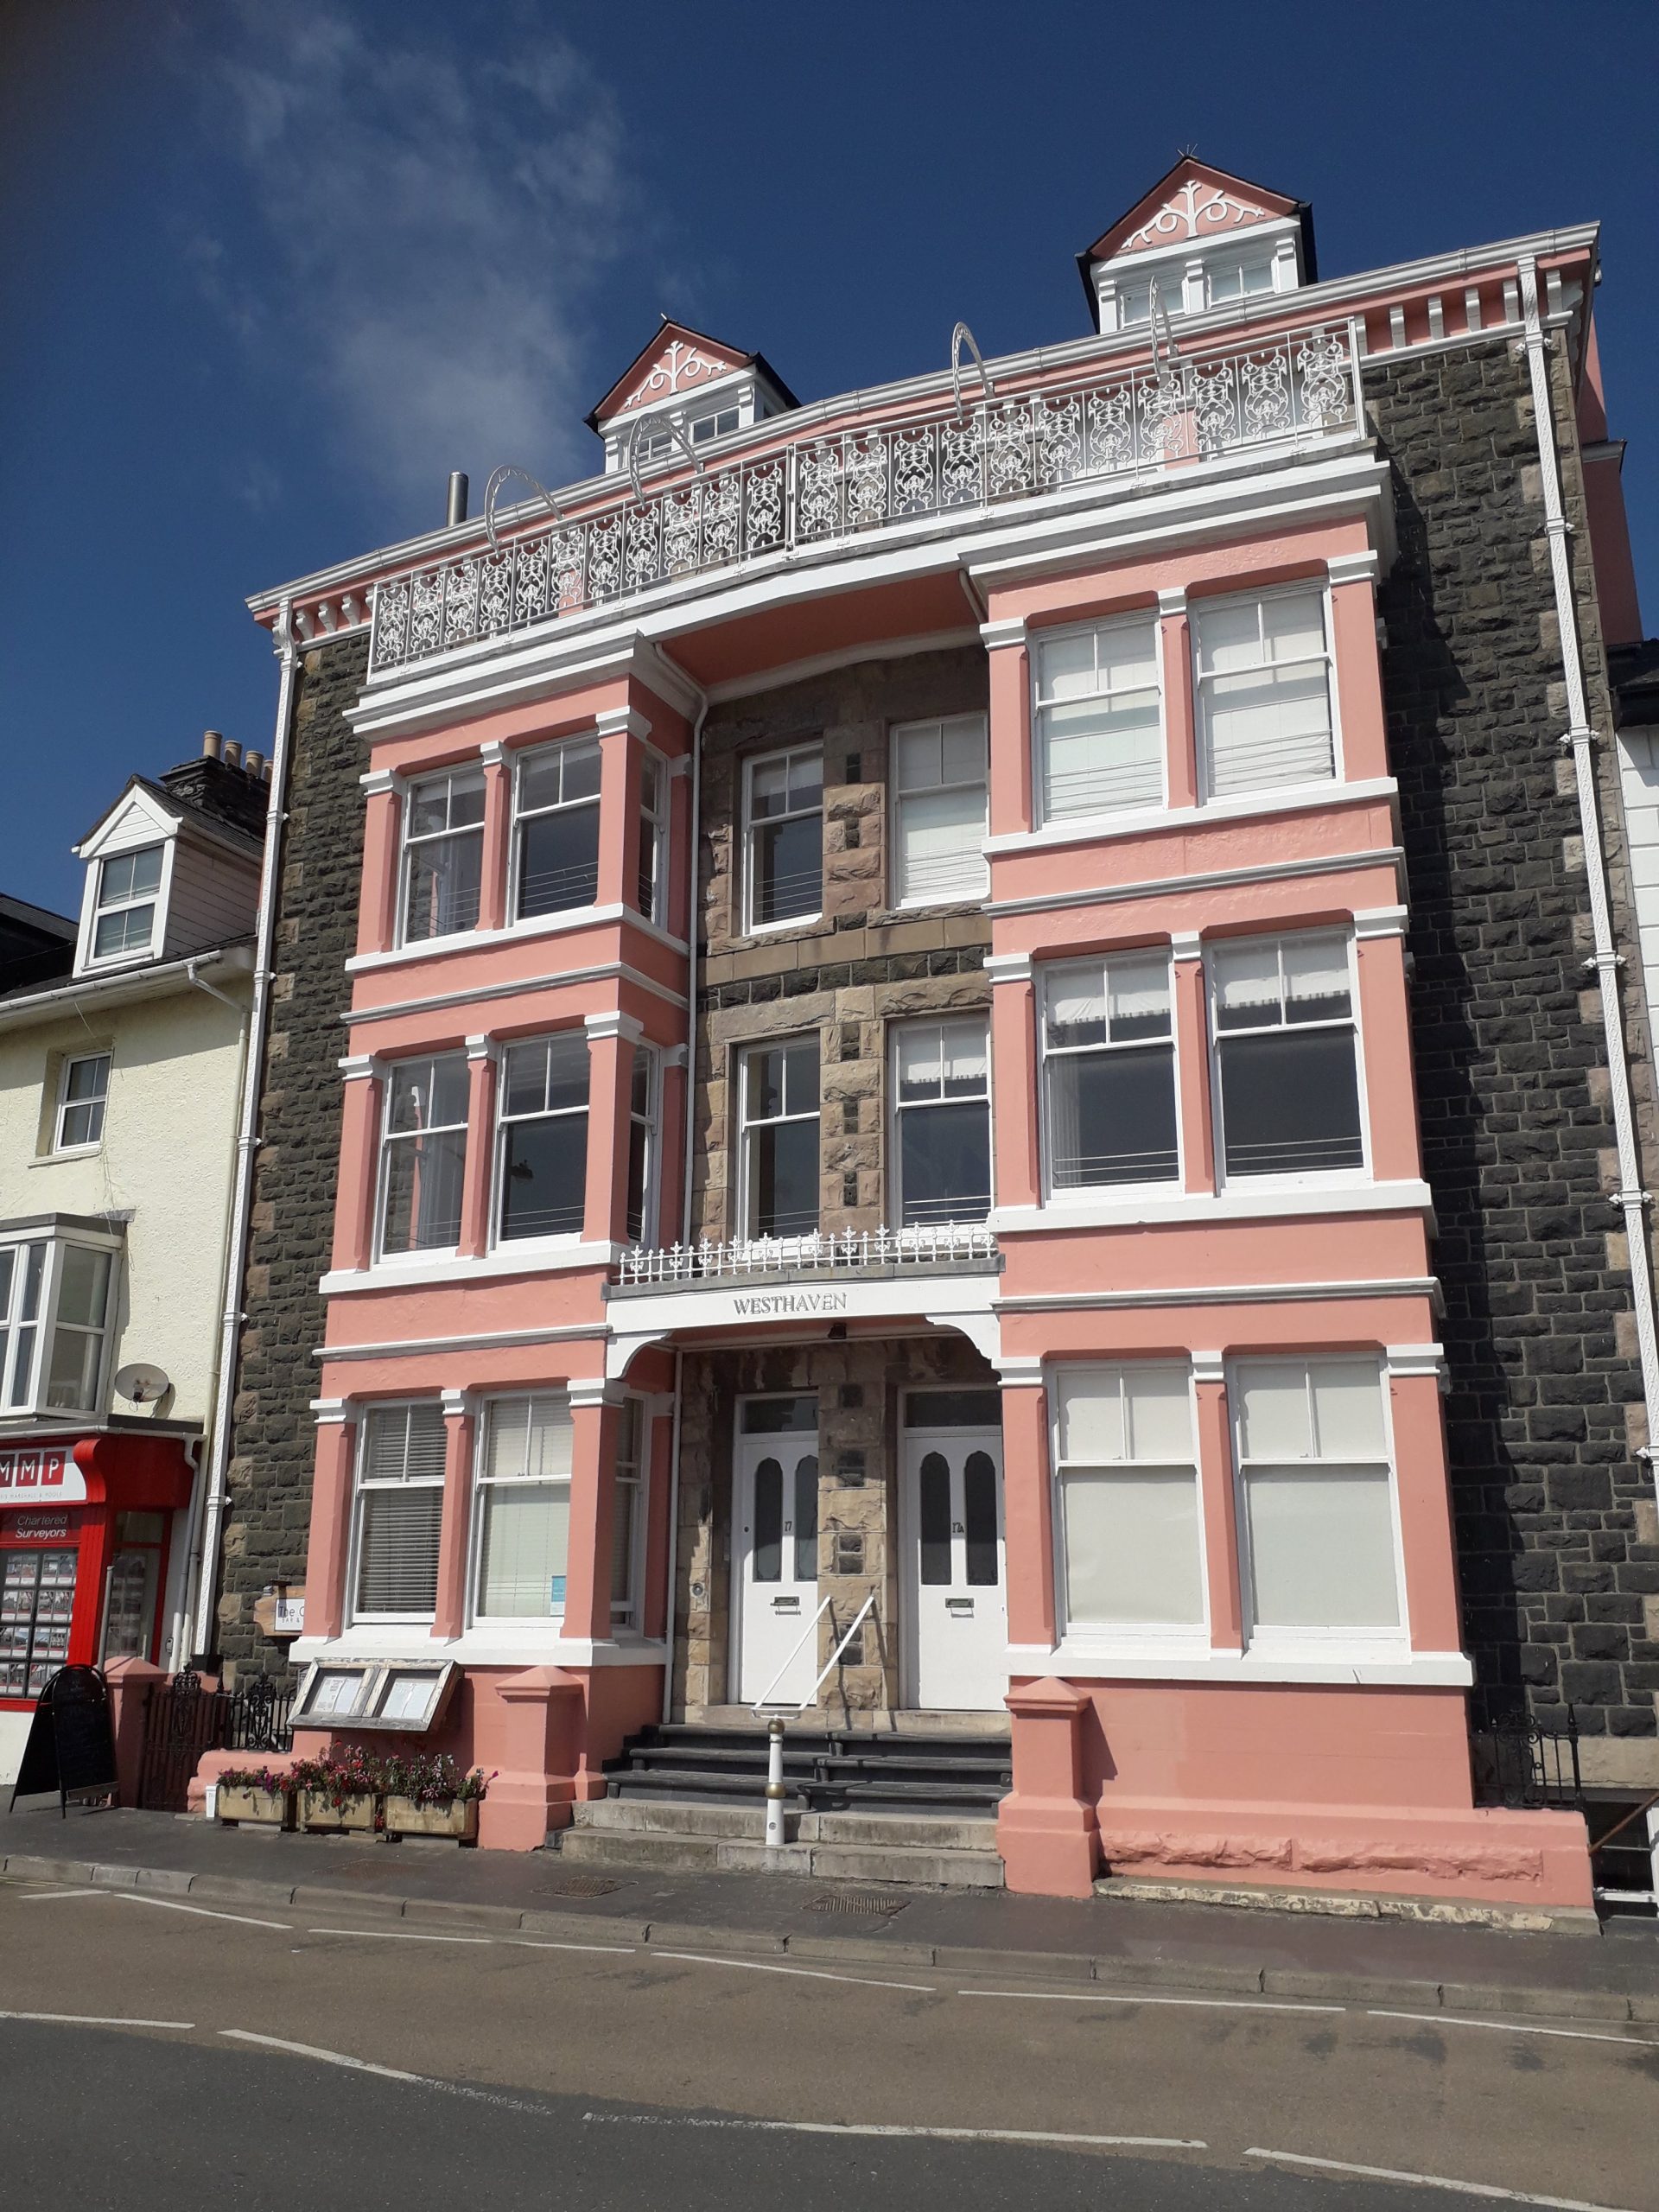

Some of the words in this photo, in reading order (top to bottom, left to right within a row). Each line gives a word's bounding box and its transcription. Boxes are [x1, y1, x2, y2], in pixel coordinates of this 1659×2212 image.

[734, 1293, 848, 1315] WESTHAVEN
[17, 1514, 68, 1526] Chartered
[785, 1521, 792, 1531] 17
[16, 1528, 67, 1541] Surveyors
